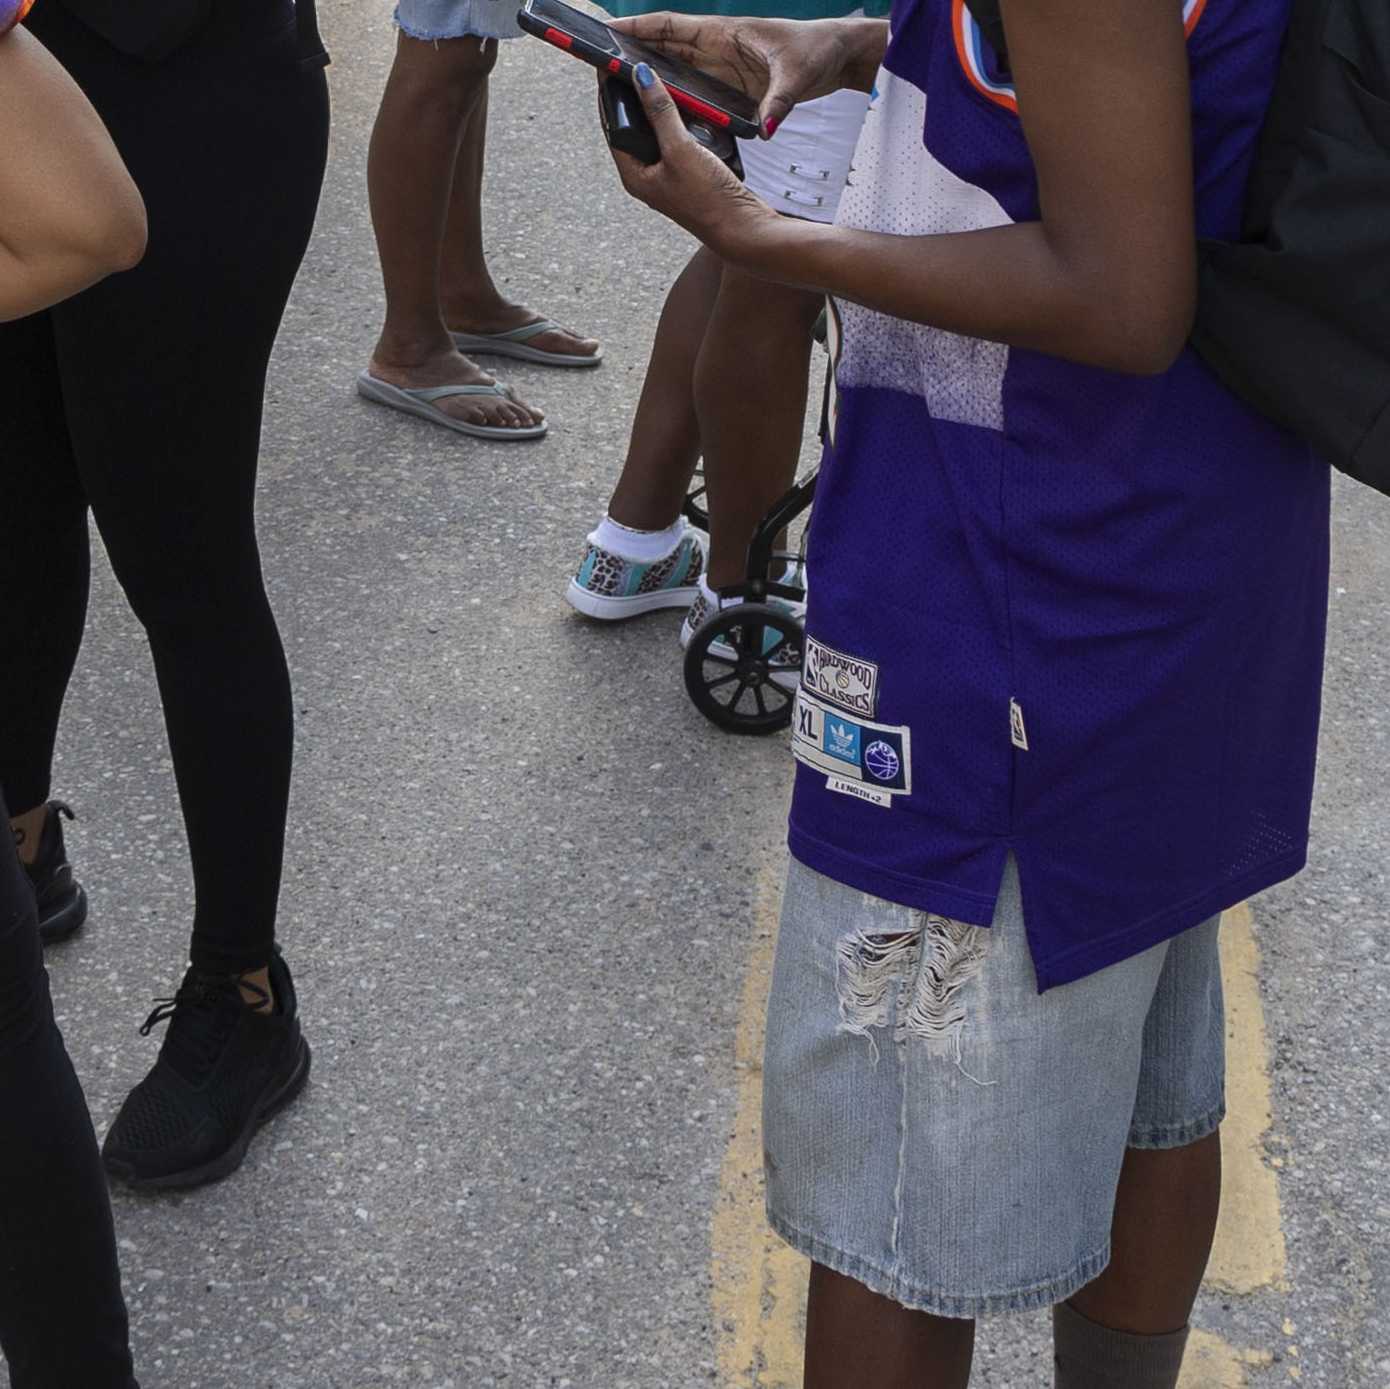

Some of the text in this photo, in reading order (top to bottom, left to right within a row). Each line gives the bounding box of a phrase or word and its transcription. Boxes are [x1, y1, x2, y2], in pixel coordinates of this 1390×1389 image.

[818, 646, 872, 691] HARDWOOD
[819, 673, 871, 711] CLASSICS
[799, 705, 818, 740] XL
[828, 743, 856, 759] adidas
[834, 781, 870, 800] LENGTH
